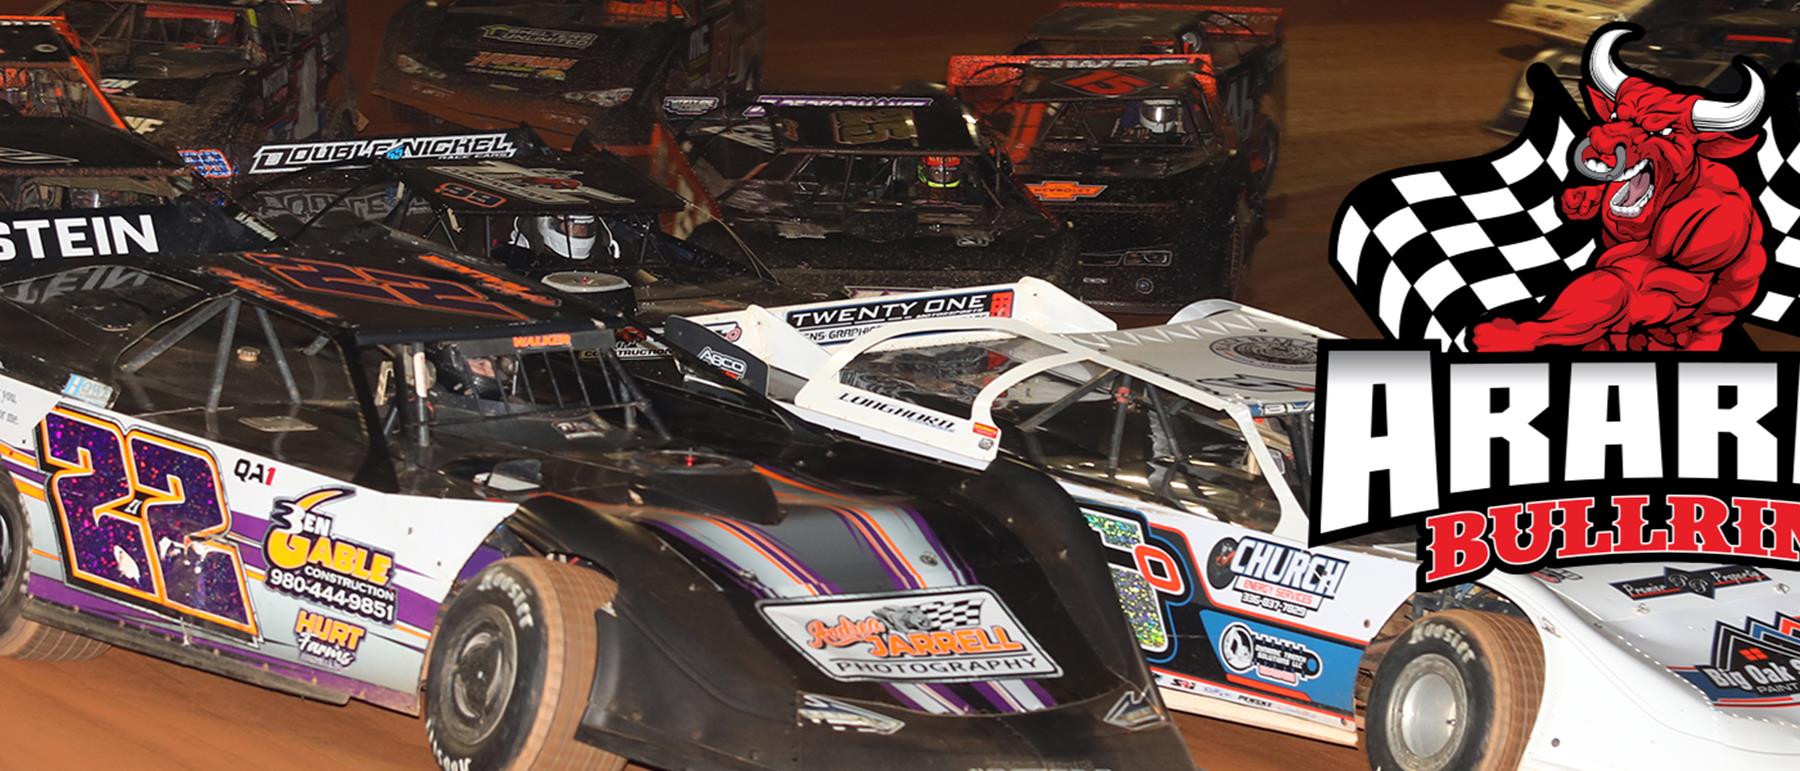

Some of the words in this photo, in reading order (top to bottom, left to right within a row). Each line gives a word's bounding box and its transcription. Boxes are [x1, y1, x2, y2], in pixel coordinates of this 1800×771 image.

[502, 32, 590, 47] UNLIMITED
[250, 139, 395, 173] DOUBLE
[401, 133, 513, 158] NICKEL
[791, 301, 920, 328] TWENTY
[923, 294, 988, 314] ONE
[511, 334, 573, 348] WALKER
[699, 347, 747, 374] ABCO
[838, 391, 956, 430] LONGHORN
[233, 457, 276, 486] QA1
[38, 402, 262, 640] 22
[267, 528, 393, 586] GABLE
[1230, 536, 1349, 599] CHURCH
[269, 568, 394, 621] 980-444-9851
[303, 565, 395, 601] CONSTRUCTION
[1243, 578, 1273, 595] ENERGY
[1274, 587, 1314, 605] SERVICES
[1621, 581, 1668, 597] Premier
[1710, 567, 1764, 585] Property
[294, 609, 366, 651] HURT
[804, 614, 887, 650] Andrea
[866, 624, 1025, 658] JARRELL
[297, 632, 356, 667] Farms
[835, 656, 1038, 676] PHOTOGRAPHY
[1702, 667, 1753, 691] Big
[1743, 661, 1797, 685] Oak
